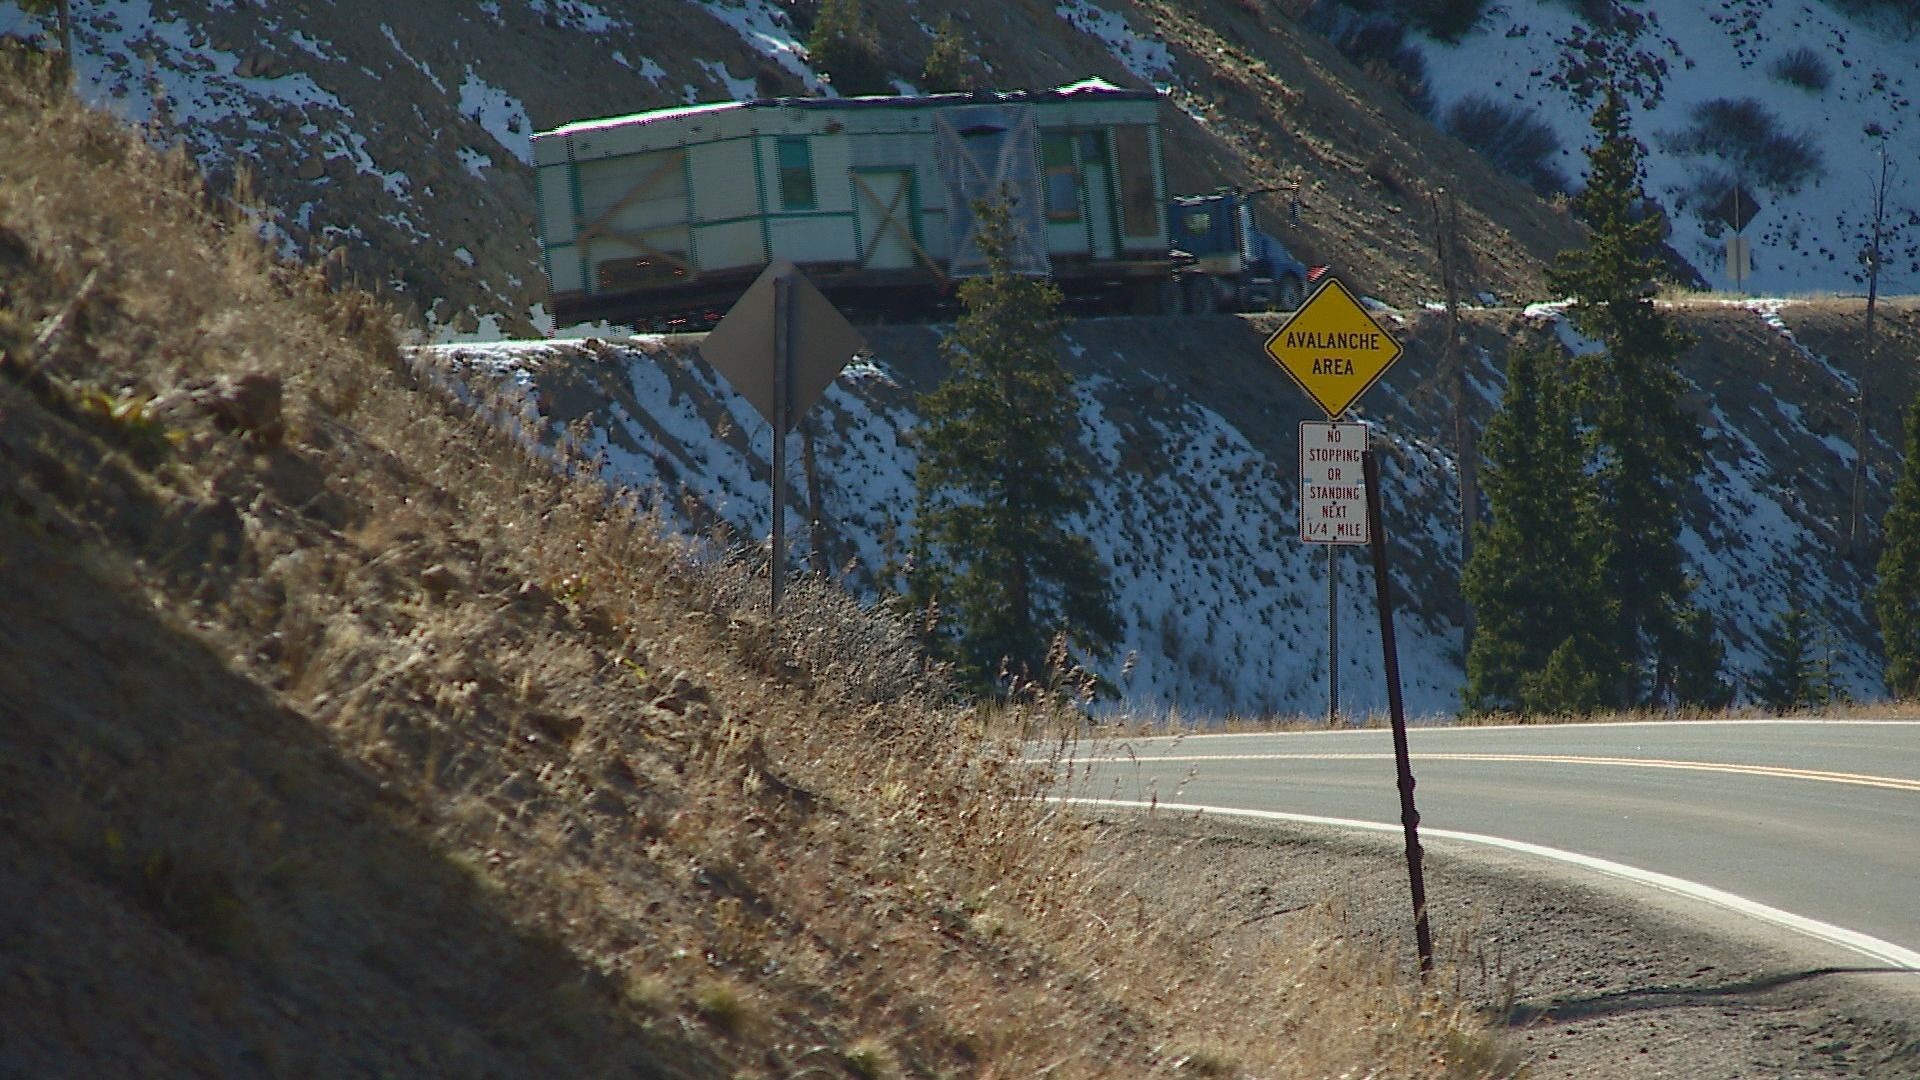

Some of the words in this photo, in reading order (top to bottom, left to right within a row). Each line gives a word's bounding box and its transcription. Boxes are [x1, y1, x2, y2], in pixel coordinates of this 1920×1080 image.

[1287, 332, 1379, 350] AVALANCHE
[1312, 358, 1354, 375] AREA
[1327, 430, 1341, 443] NO
[1309, 449, 1360, 462] STOPPING
[1327, 468, 1342, 481] OR
[1310, 486, 1360, 500] STANDING
[1322, 505, 1346, 518] NEXT
[1308, 522, 1328, 536] 1/4
[1337, 523, 1361, 537] MILE
